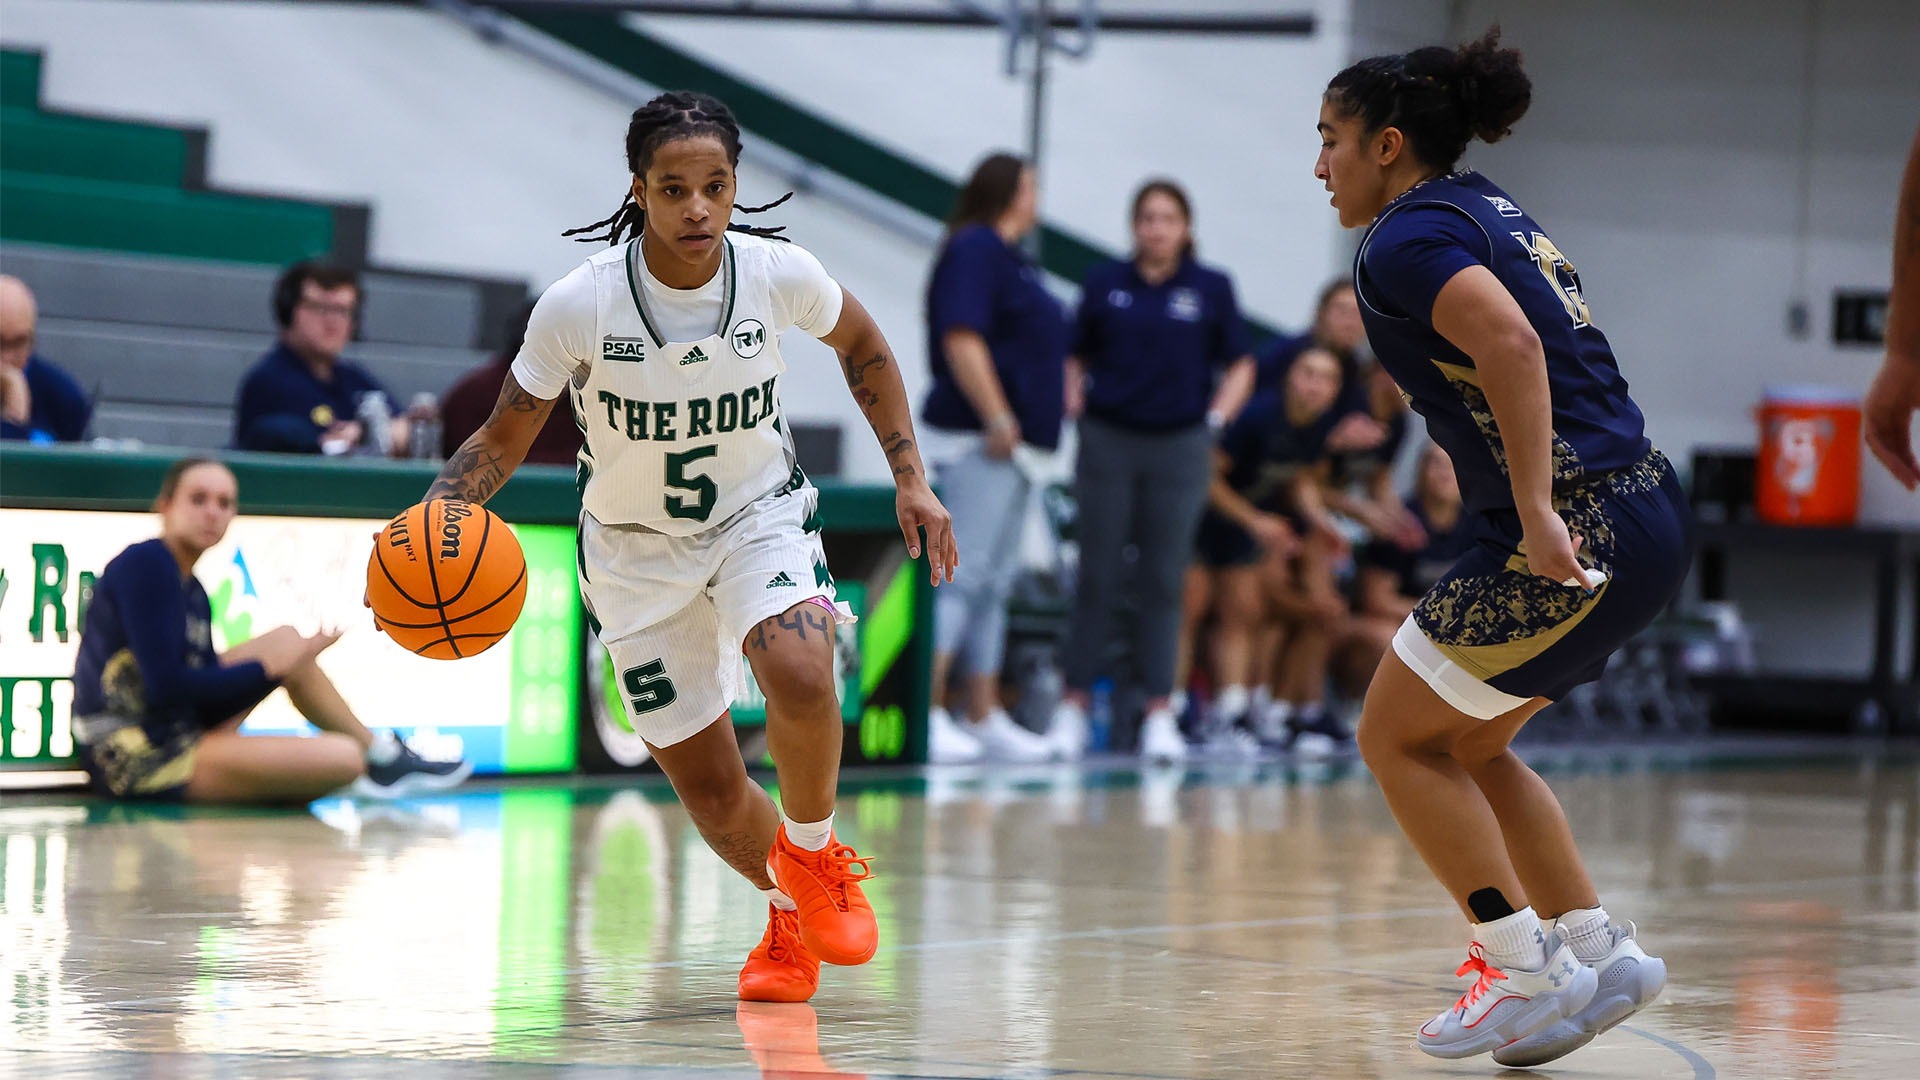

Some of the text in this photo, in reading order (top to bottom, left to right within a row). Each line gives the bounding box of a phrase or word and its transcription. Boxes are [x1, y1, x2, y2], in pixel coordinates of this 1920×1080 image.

[603, 341, 645, 356] PSAC
[679, 354, 709, 366] adidas
[598, 374, 779, 441] THE ROCK
[664, 444, 719, 523] 5
[441, 499, 472, 559] ilson
[405, 543, 417, 562] NXT
[766, 581, 797, 589] adidas
[622, 658, 678, 716] S
